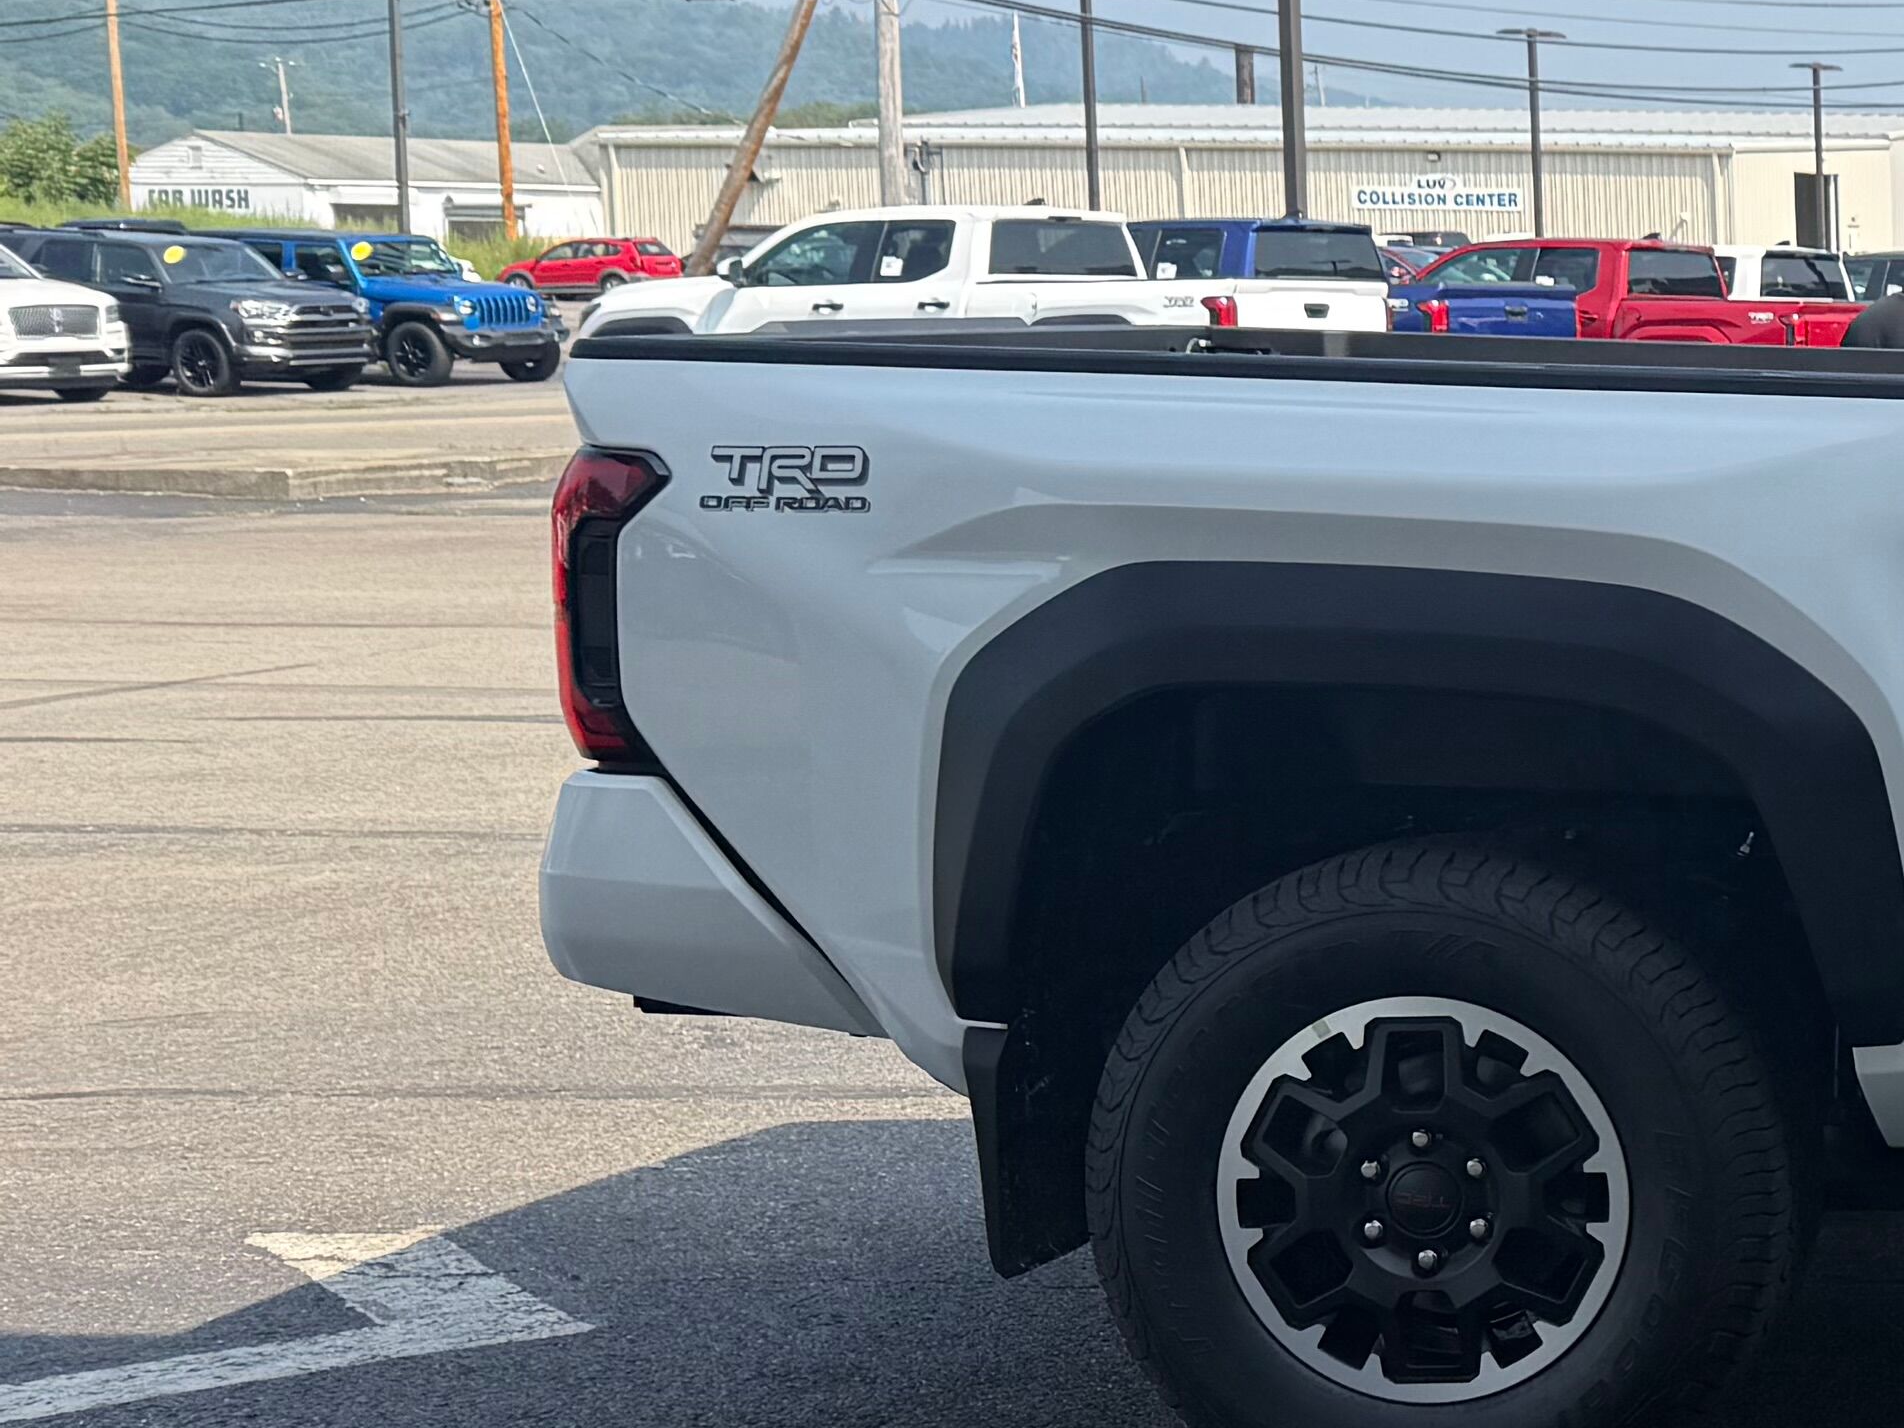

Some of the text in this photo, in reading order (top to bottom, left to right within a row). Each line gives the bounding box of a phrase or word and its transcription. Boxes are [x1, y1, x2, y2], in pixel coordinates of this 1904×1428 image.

[1416, 178, 1447, 190] LUV
[190, 188, 250, 209] WASH
[1357, 190, 1518, 207] COLLISION CENTER
[711, 445, 870, 496] TRD
[699, 495, 871, 513] OFF ROAD
